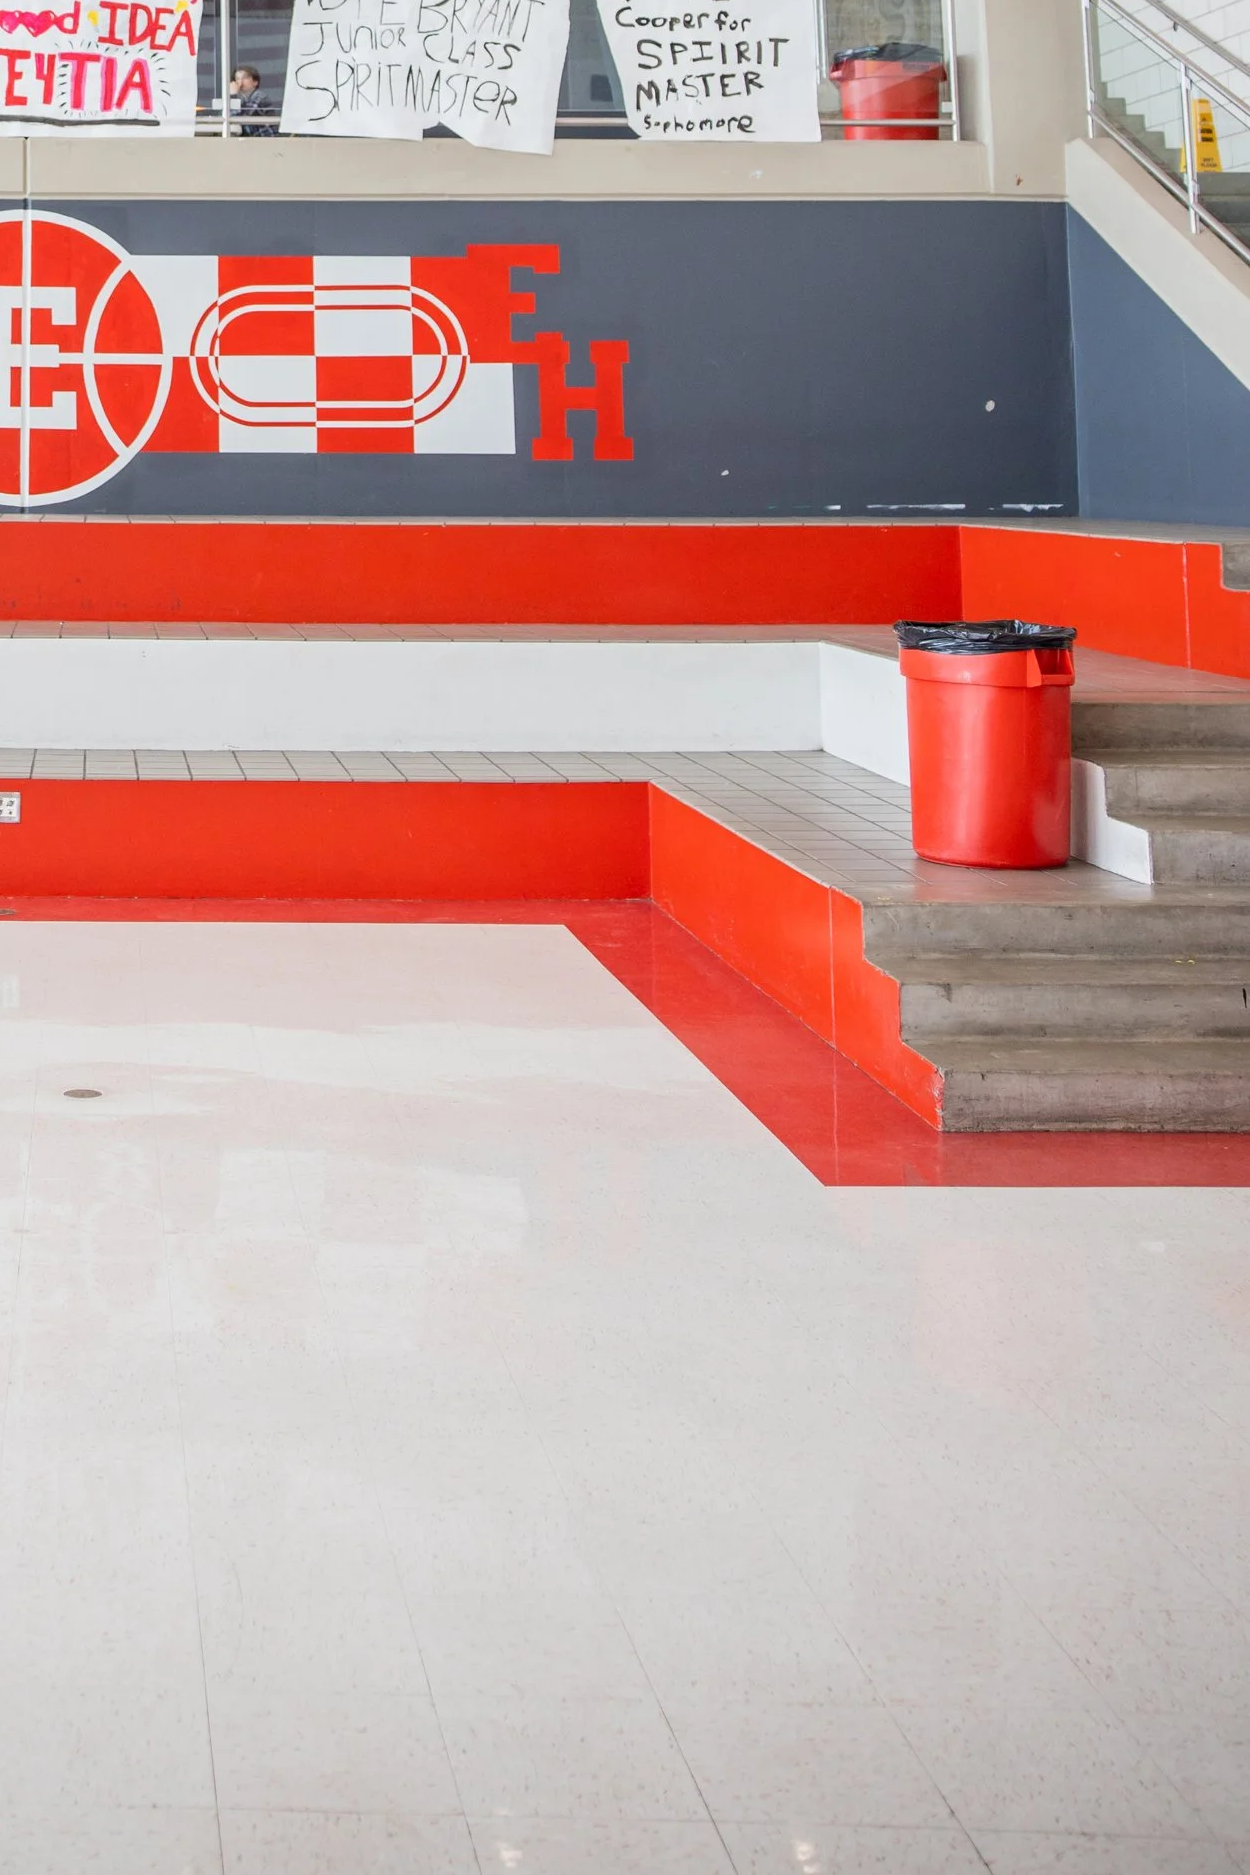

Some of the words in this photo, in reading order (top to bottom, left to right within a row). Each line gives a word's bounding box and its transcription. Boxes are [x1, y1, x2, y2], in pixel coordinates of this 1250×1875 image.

[97, 0, 196, 56] IDEA
[615, 6, 710, 32] Cooper
[714, 10, 752, 32] for
[422, 32, 522, 70] CLASS
[636, 71, 765, 112] MASTER
